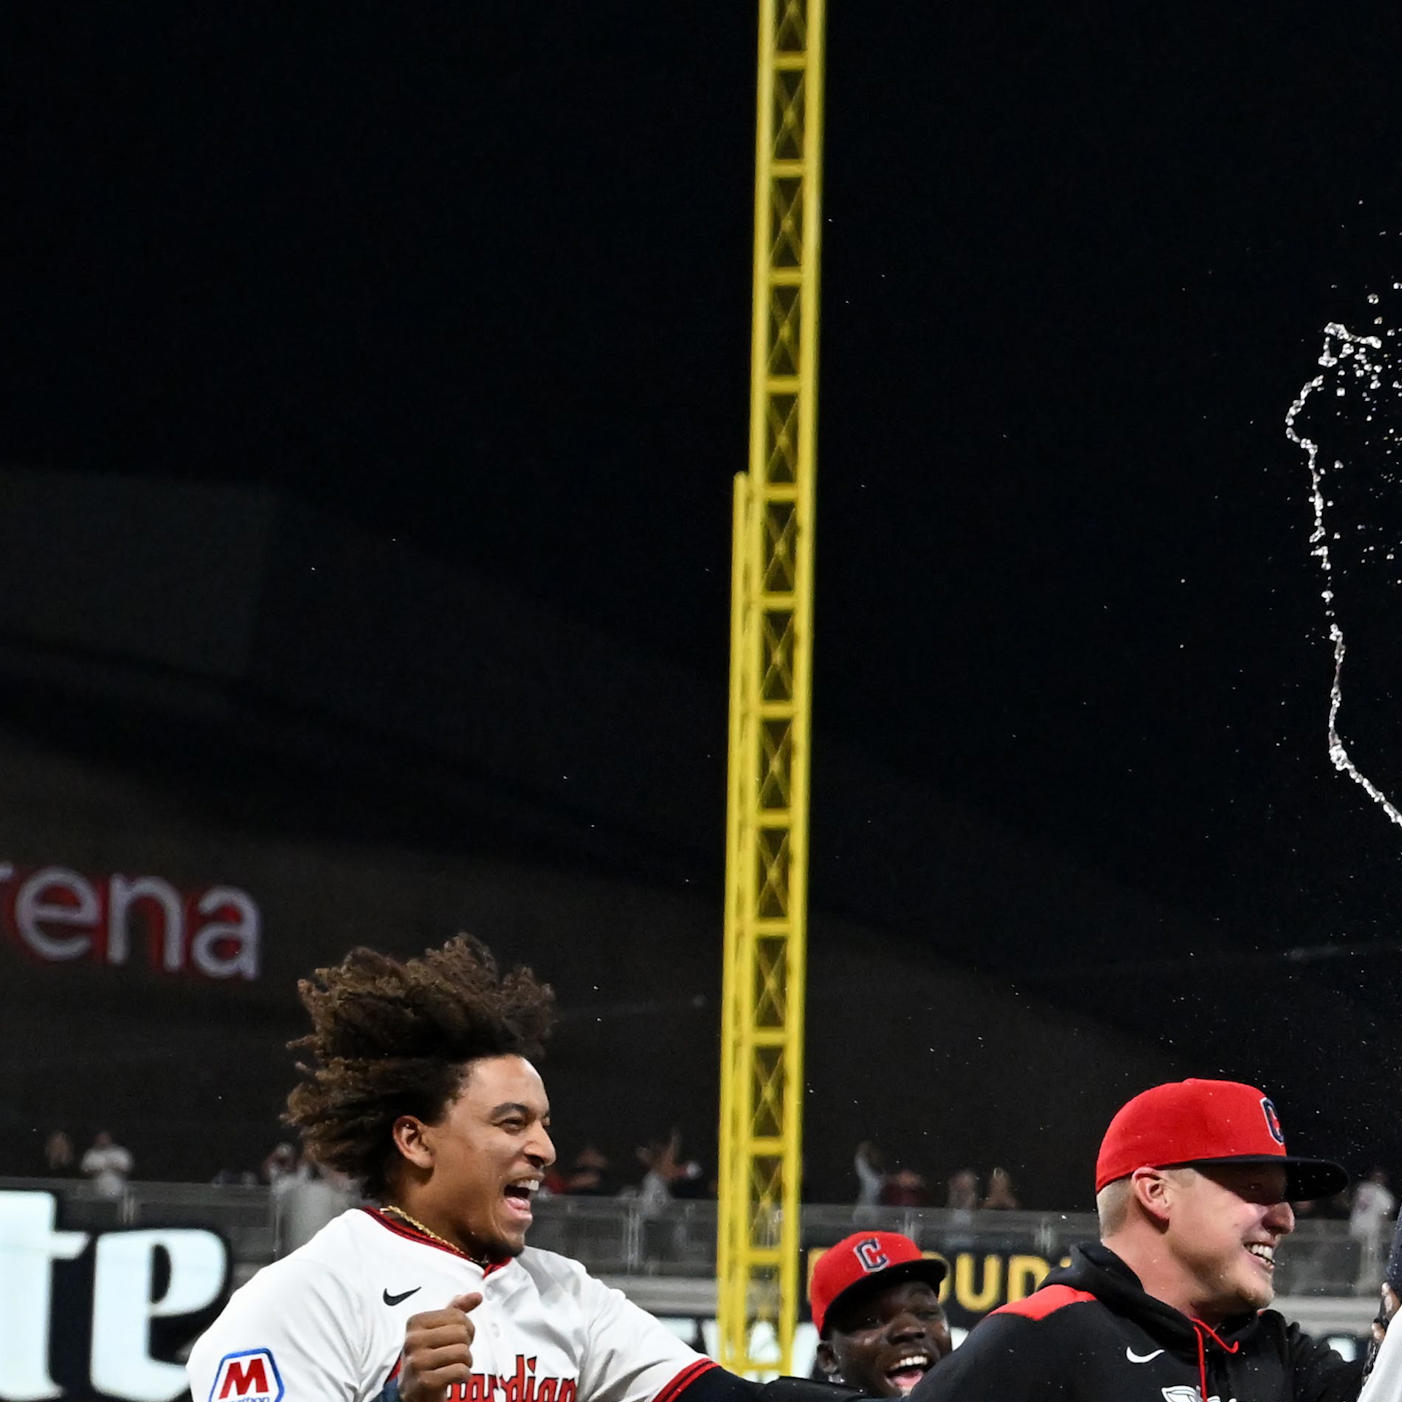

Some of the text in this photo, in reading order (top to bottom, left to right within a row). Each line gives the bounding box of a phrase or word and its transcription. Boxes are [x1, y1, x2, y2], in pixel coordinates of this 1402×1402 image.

[0, 862, 261, 980] ena
[853, 1237, 890, 1273] C
[218, 1357, 269, 1400] M
